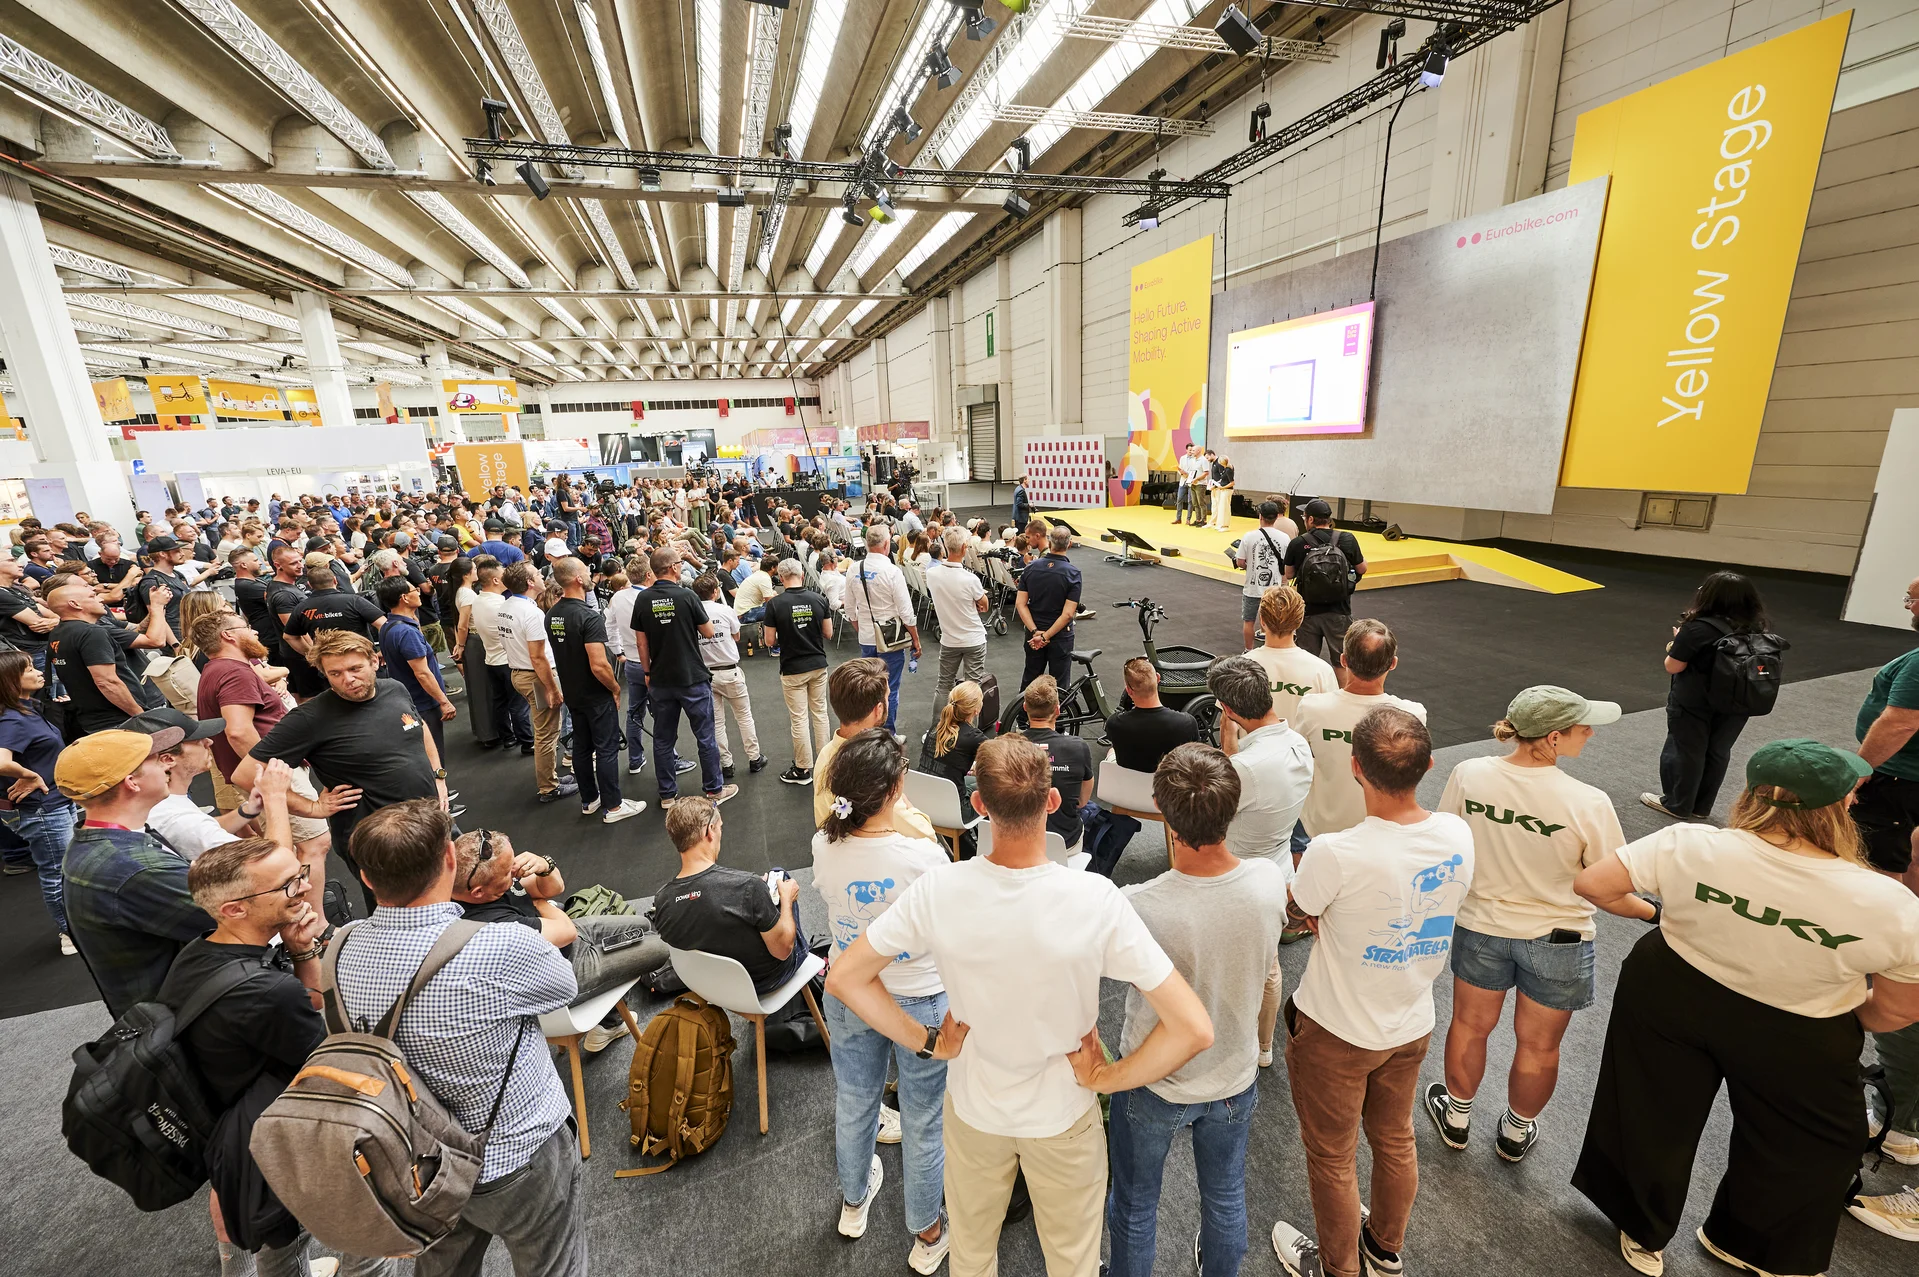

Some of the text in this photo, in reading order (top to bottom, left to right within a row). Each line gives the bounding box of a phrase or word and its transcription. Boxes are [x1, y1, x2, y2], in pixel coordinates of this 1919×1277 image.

[1485, 208, 1579, 241] Eurobike.com
[1657, 84, 1773, 428] Yellow Stage
[1134, 299, 1188, 326] Hello Future.
[1133, 317, 1202, 346] Shaping Active
[1133, 346, 1167, 363] Mobility.
[266, 467, 302, 476] LEVA-EU
[1269, 682, 1312, 696] UKY
[1465, 799, 1566, 837] PUKY
[1695, 882, 1864, 950] PUKY
